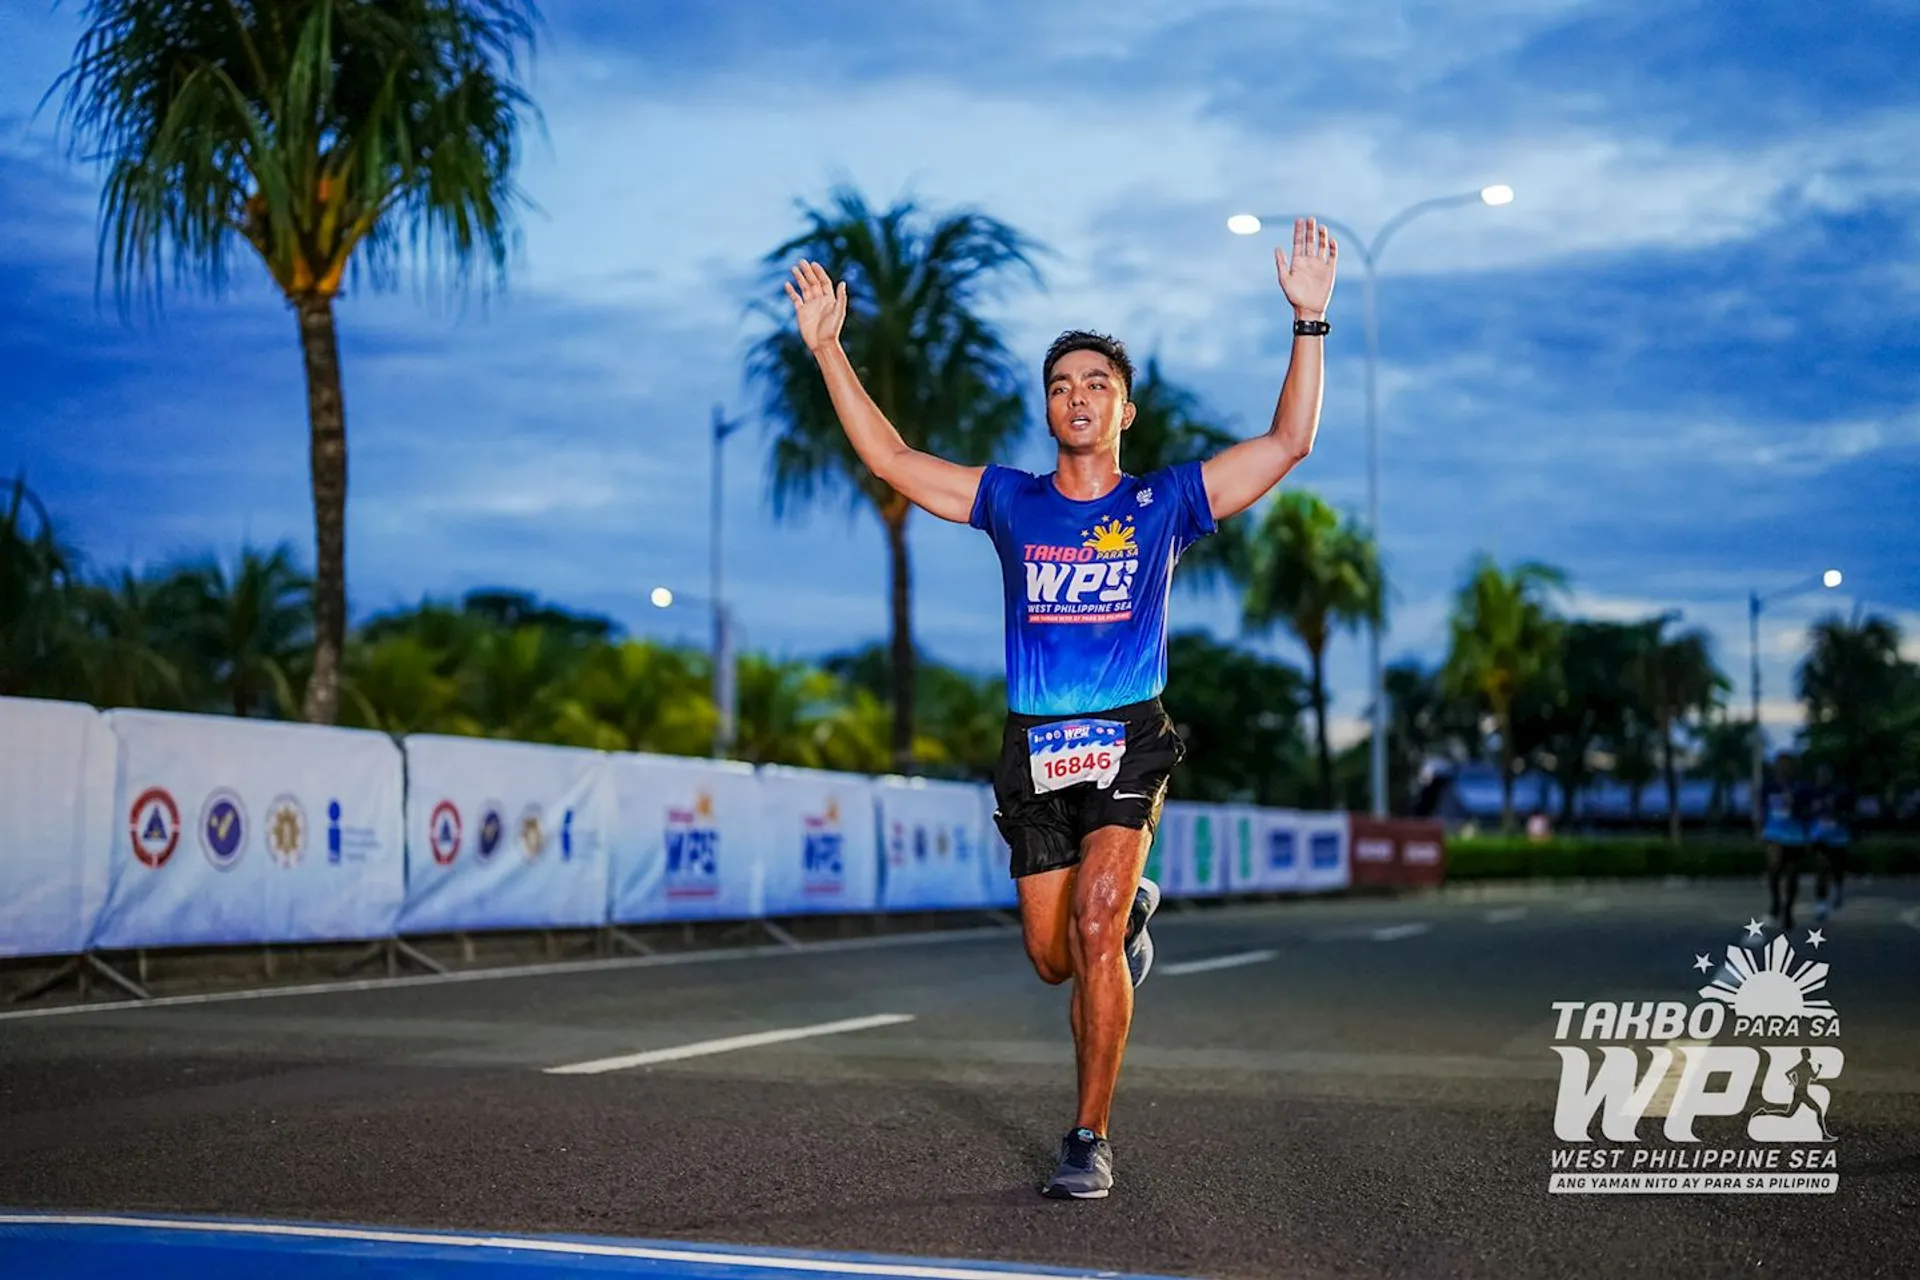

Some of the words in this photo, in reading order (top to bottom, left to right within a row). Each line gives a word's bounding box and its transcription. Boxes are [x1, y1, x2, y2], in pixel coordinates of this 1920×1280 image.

[1096, 549, 1124, 560] PARA
[1126, 547, 1138, 558] SA
[1023, 559, 1139, 603] WPS
[1027, 604, 1052, 613] WEST
[1053, 604, 1112, 613] PHILIPPINE
[1113, 601, 1132, 611] SEA
[1044, 752, 1111, 779] 16846
